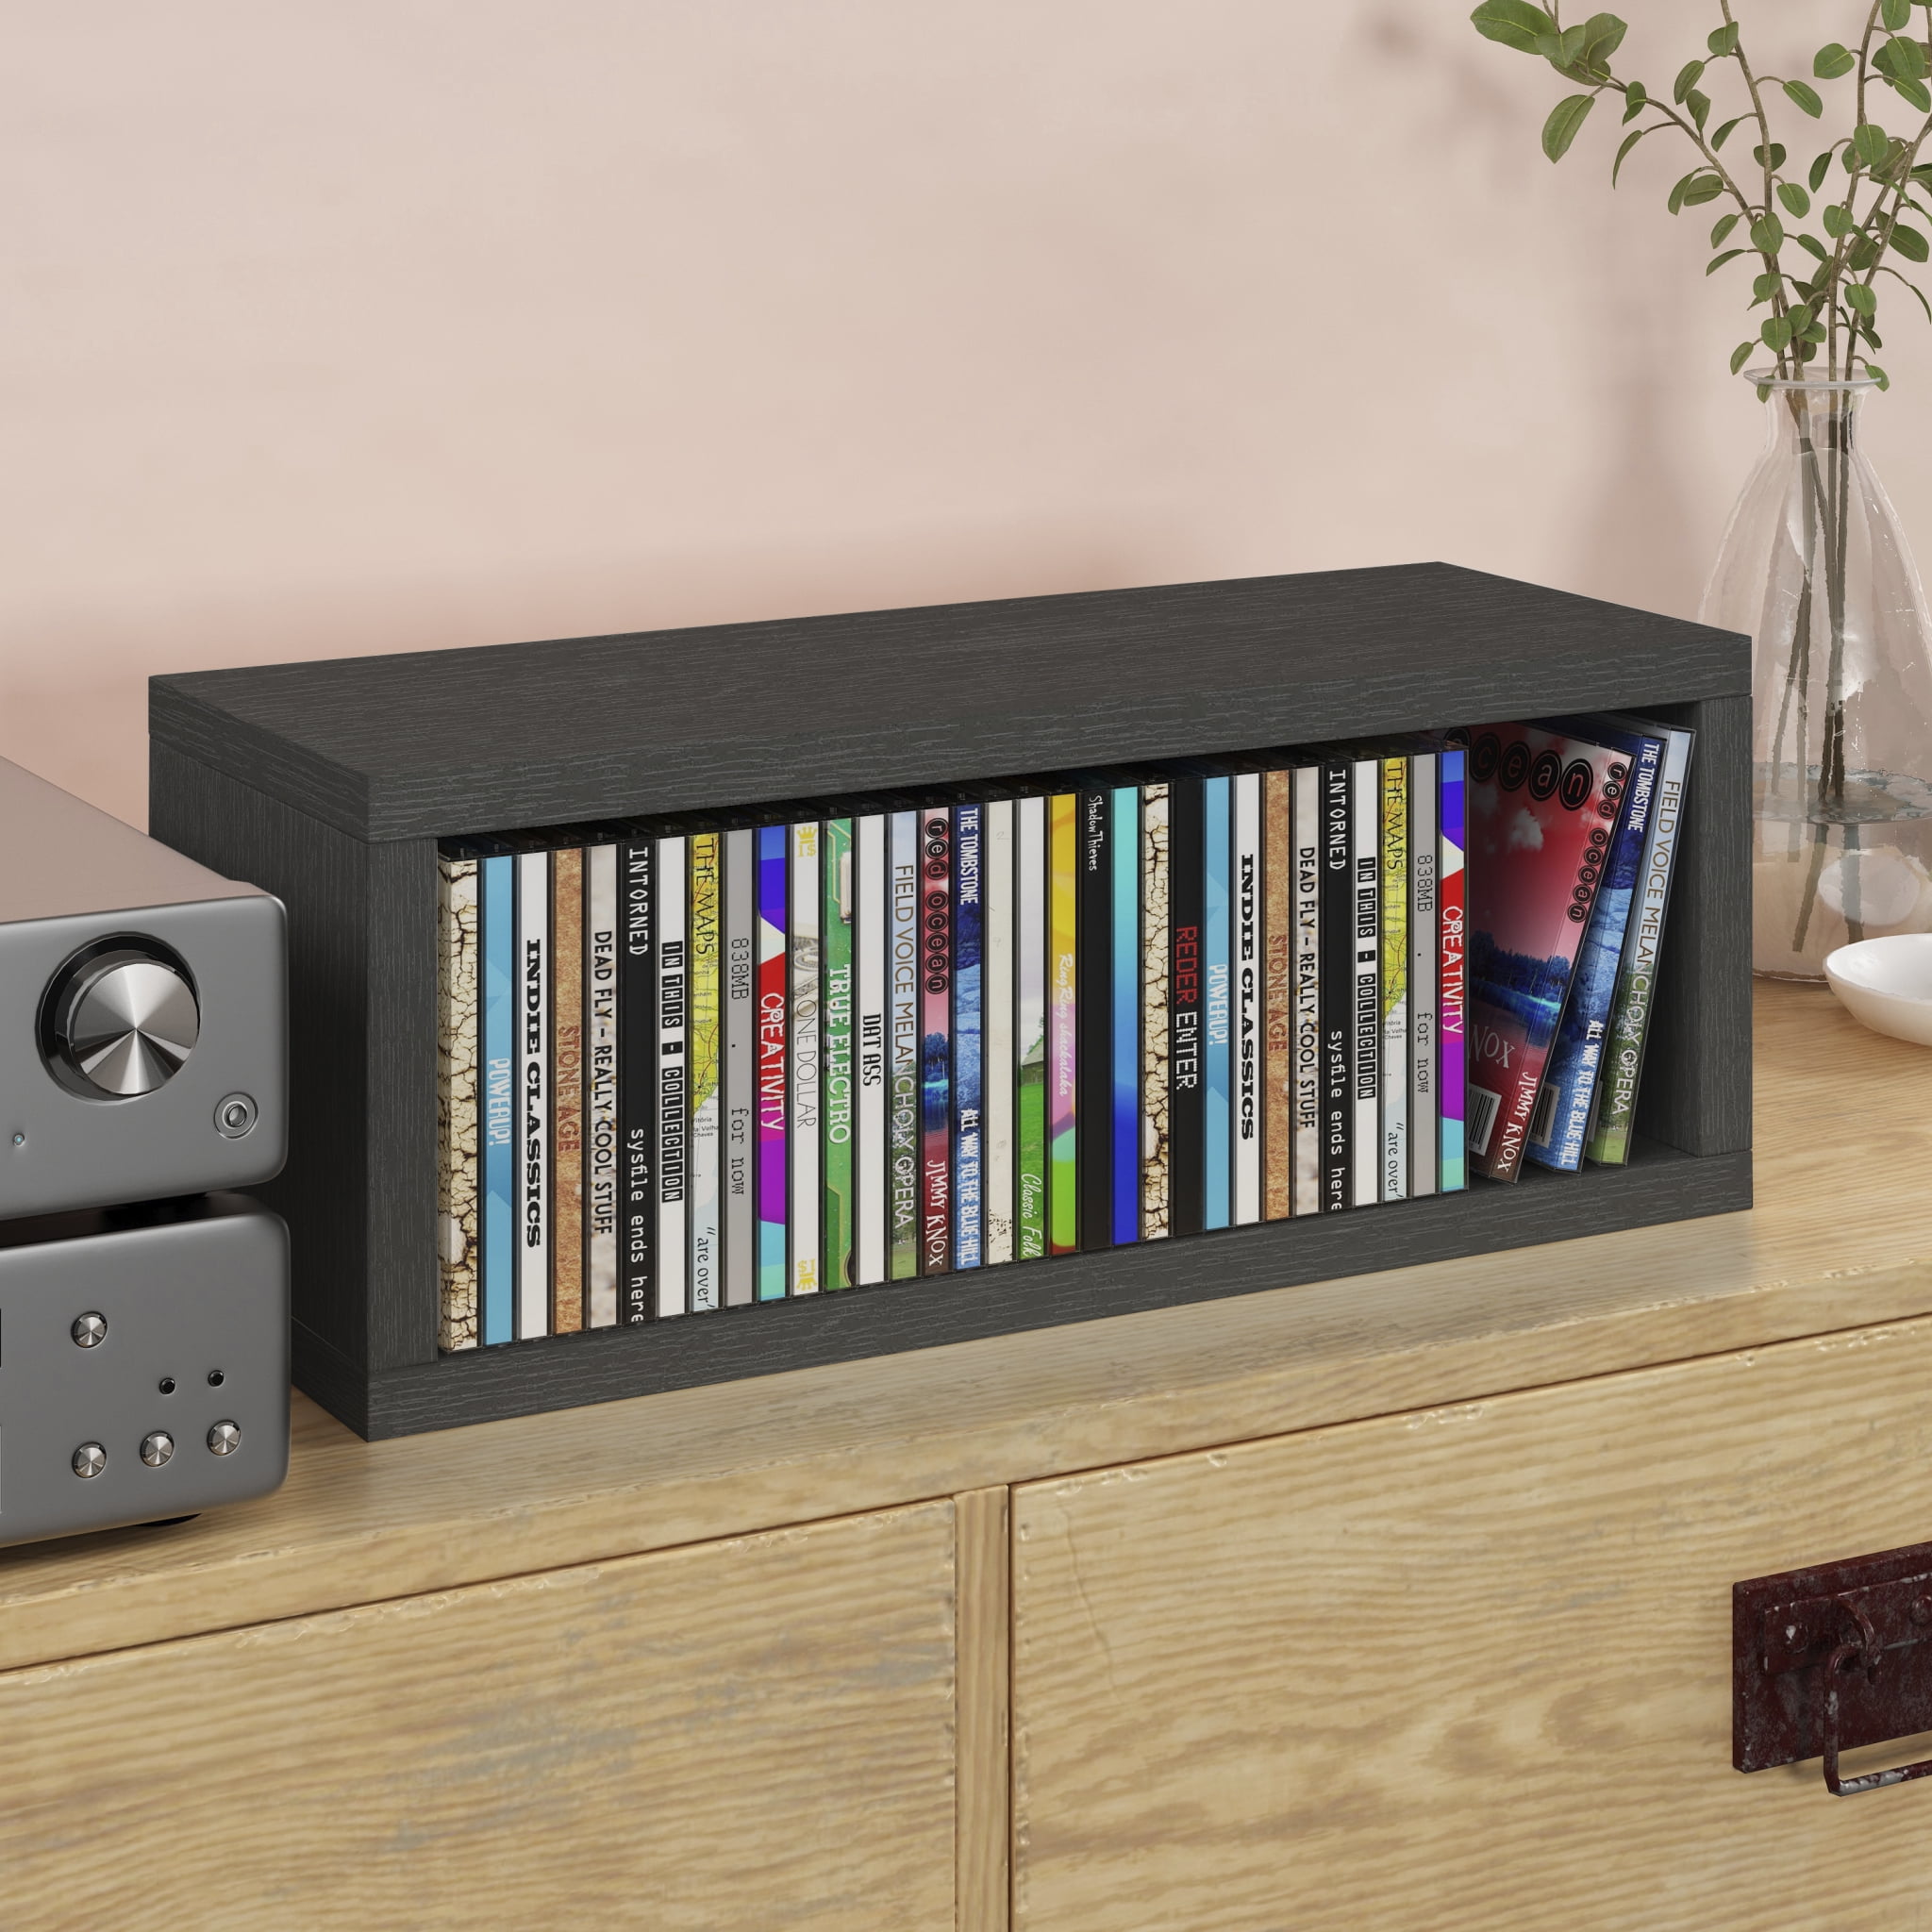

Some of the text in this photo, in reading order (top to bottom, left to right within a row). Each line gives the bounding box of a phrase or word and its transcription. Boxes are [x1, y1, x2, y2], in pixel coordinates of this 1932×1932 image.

[1386, 761, 1404, 807] THE
[1448, 731, 1590, 807] cean
[1627, 742, 1660, 833] THE TOMBSTONE
[960, 808, 979, 907] THE TOMBSTONE
[1329, 769, 1347, 871] INTORNED
[1386, 811, 1404, 871] MAPS
[1569, 763, 1626, 922] red ocean
[696, 837, 715, 887] THE
[1299, 846, 1316, 894] DEAD
[1357, 857, 1376, 883] IN
[1417, 854, 1434, 913] 838MB
[628, 846, 649, 957] INTORNED
[695, 891, 715, 956] MAPS
[927, 819, 948, 993] red ocean
[1299, 897, 1316, 929] FLY
[1357, 887, 1376, 939] THIS
[593, 930, 612, 982] DEAD
[661, 941, 684, 969] IN
[731, 937, 750, 1001] 838MB
[1299, 952, 1316, 1014] REALLY
[1442, 905, 1464, 1034] CREATIVITY
[1612, 779, 1681, 1116] FIELD VOICE MELANCHOLY OPERA
[593, 988, 612, 1020] FLY
[661, 974, 684, 1029] THIS
[1175, 924, 1199, 1091] REDER ENTER
[1208, 963, 1228, 1046] POWERUP!
[1241, 853, 1255, 1141] INDIE CLASSICS
[1268, 933, 1289, 1052] STONE AGE
[1417, 1011, 1434, 1046] for
[760, 992, 785, 1131] CREATIVITY
[796, 998, 818, 1129] ONE DOLLAR
[828, 962, 852, 1144] TRUE ELECTRO
[862, 1013, 882, 1088] DAT ASS
[895, 864, 915, 1229] FIELD VOICE MELANCHOLY OPERA
[1299, 1022, 1316, 1074] COOL
[1357, 973, 1376, 1101] COLLECTION
[1468, 1024, 1515, 1069] NOX
[488, 1058, 511, 1146] POWERUP!
[526, 939, 541, 1249] INDIE CLASSICS
[558, 1024, 581, 1153] STONE AGE
[593, 1043, 612, 1111] REALLY
[1299, 1079, 1316, 1128] STUFF
[1417, 1058, 1429, 1093] now
[1560, 1019, 1605, 1166] ALL WAY TO THE BLUE HILL
[593, 1119, 612, 1175] COOL
[661, 1066, 684, 1204] COLLECTION
[731, 1107, 750, 1145] for
[1327, 1029, 1346, 1210] sysfile ends here
[1497, 1071, 1539, 1174] JIMMY KNOX
[626, 1127, 648, 1202] sysfile
[731, 1157, 744, 1196] now
[960, 1107, 979, 1266] ALL WAY TO THE BLUE HILL
[593, 1181, 612, 1235] STUFF
[630, 1213, 648, 1264] ends
[925, 1159, 949, 1268] JIMMY KNOX
[1021, 1173, 1043, 1257] Classic Folk
